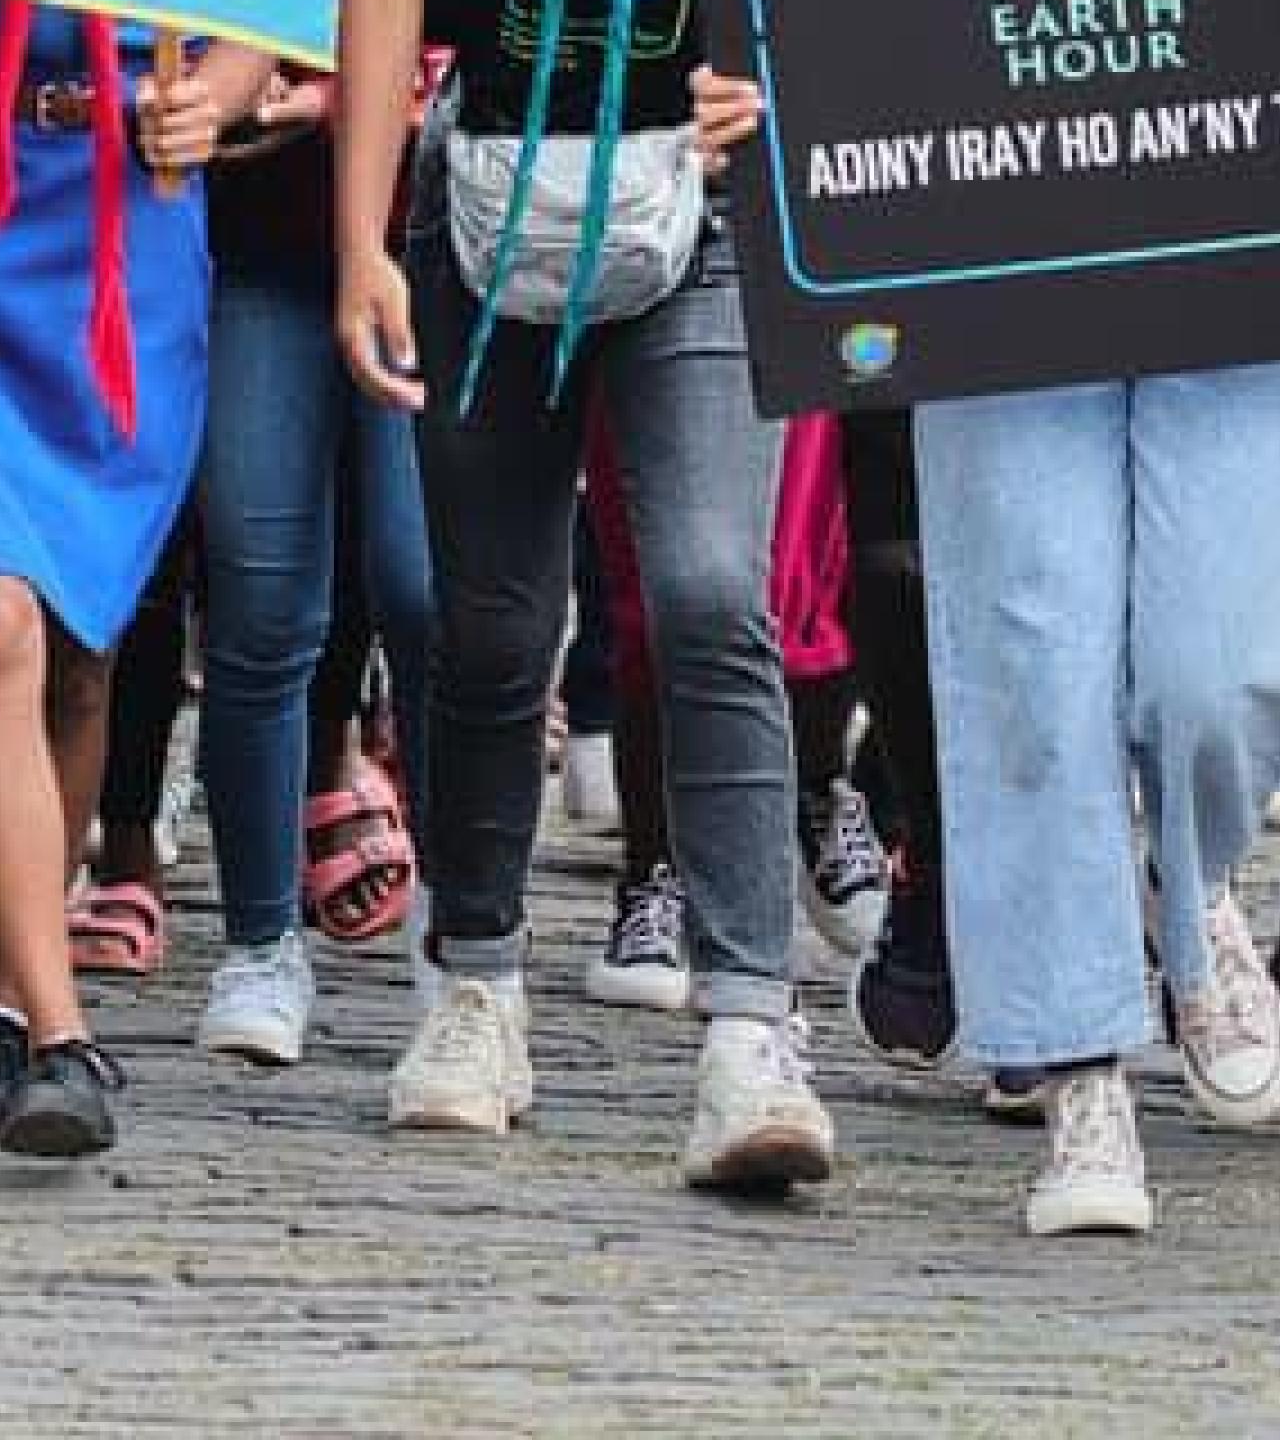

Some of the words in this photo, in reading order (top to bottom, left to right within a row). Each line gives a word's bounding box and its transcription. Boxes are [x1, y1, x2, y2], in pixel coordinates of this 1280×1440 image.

[1004, 32, 1186, 87] HOUR
[810, 132, 933, 197] ADINY
[946, 120, 1045, 181] IRAY
[1056, 112, 1118, 169] HO
[1130, 96, 1262, 161] AN'NY
